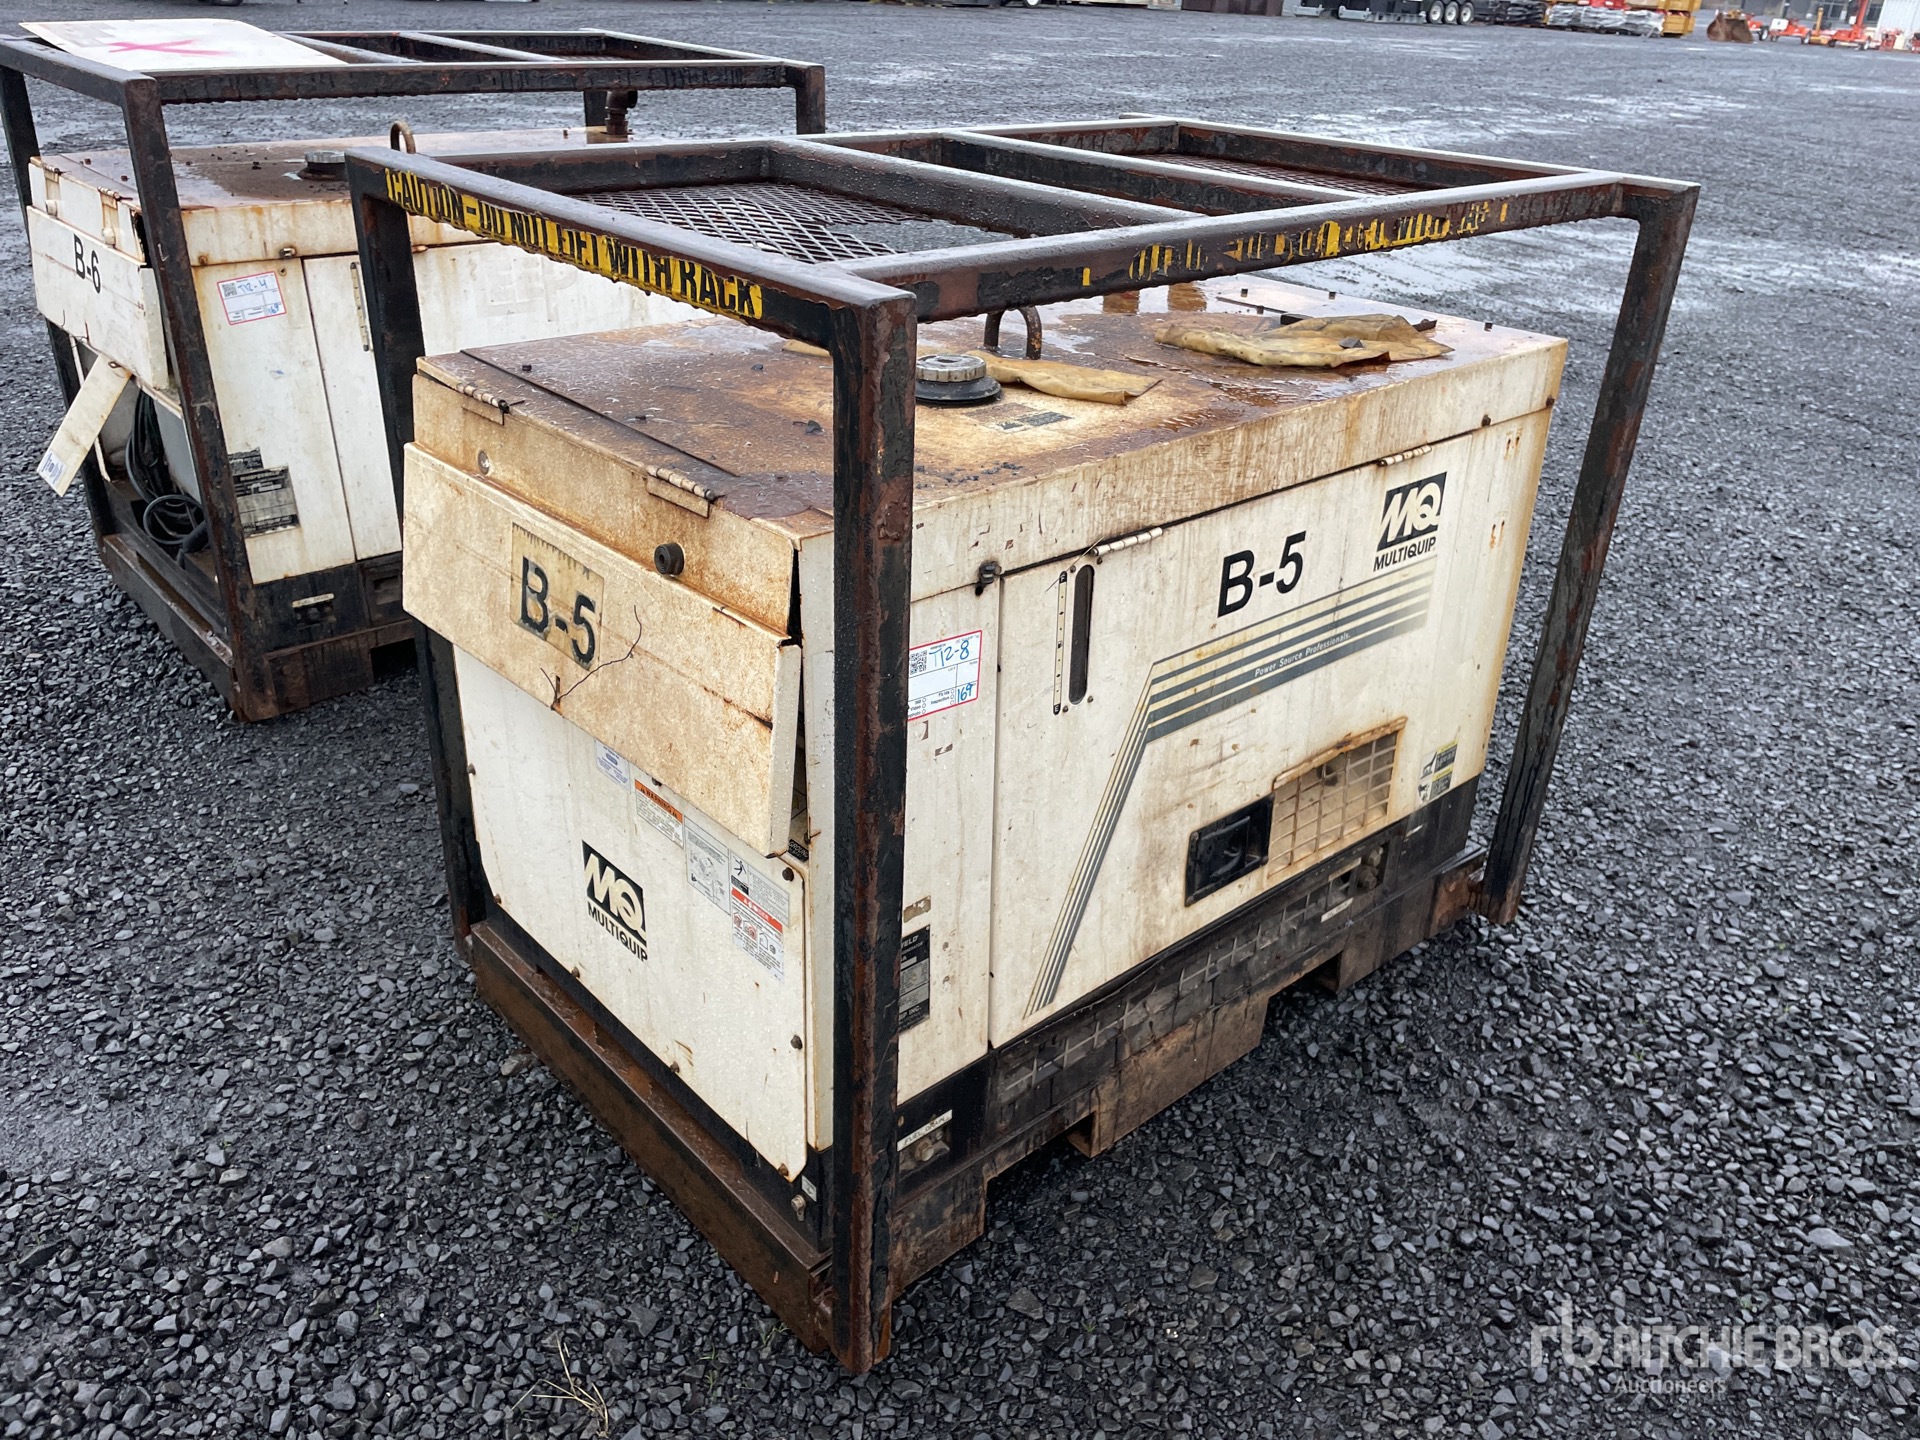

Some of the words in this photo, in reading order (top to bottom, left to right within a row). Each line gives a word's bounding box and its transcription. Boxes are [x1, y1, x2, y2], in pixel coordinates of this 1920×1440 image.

[73, 233, 101, 294] B-6
[679, 258, 754, 316] RACK
[1378, 479, 1443, 549] MQ
[1217, 530, 1307, 618] B-5
[1373, 536, 1437, 572] MULTIQUIP
[520, 555, 596, 665] B-5
[1254, 663, 1277, 678] Power
[1279, 653, 1303, 667] Source
[584, 851, 647, 944] MQ
[587, 901, 649, 962] MULTIQUIP
